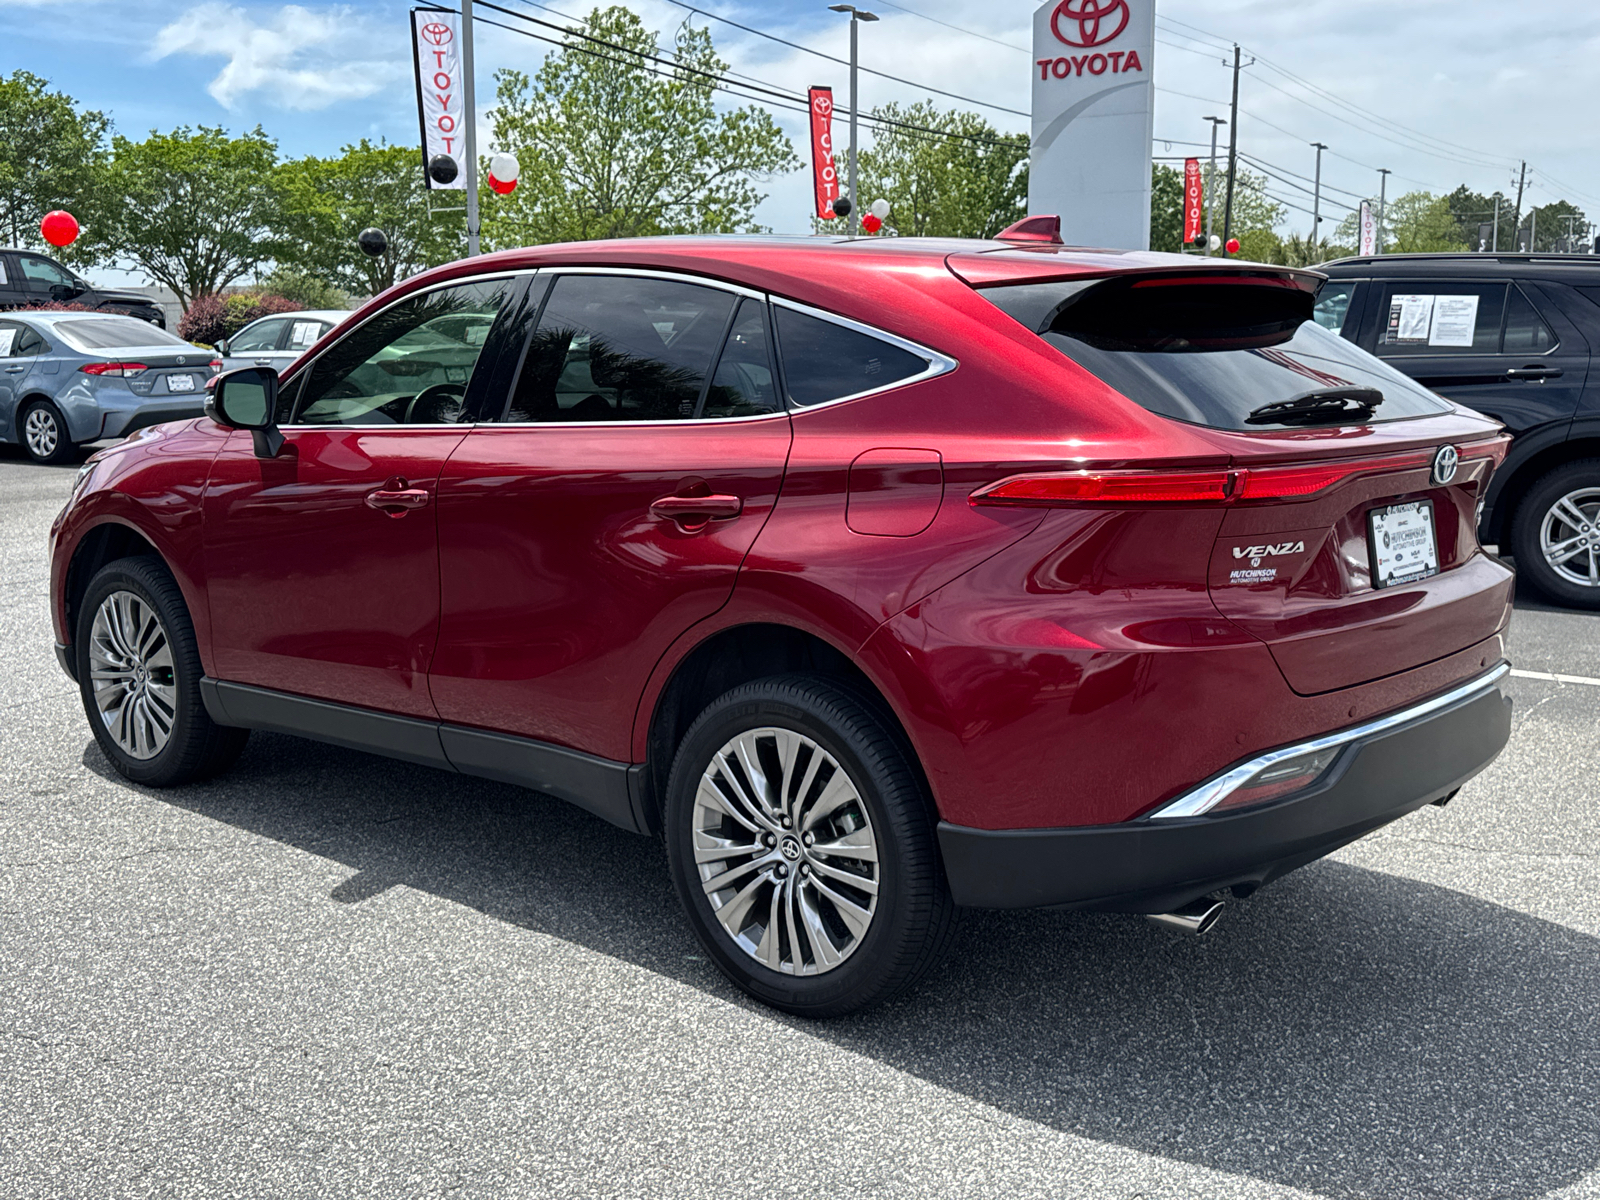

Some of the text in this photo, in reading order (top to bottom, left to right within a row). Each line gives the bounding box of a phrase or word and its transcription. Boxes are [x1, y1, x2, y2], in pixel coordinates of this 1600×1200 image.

[1036, 50, 1143, 81] TOYOTA
[433, 51, 455, 154] TOYOT
[1189, 176, 1200, 240] TOYOTA
[1233, 541, 1304, 559] VENZA
[1230, 569, 1276, 578] HUTCHINSON
